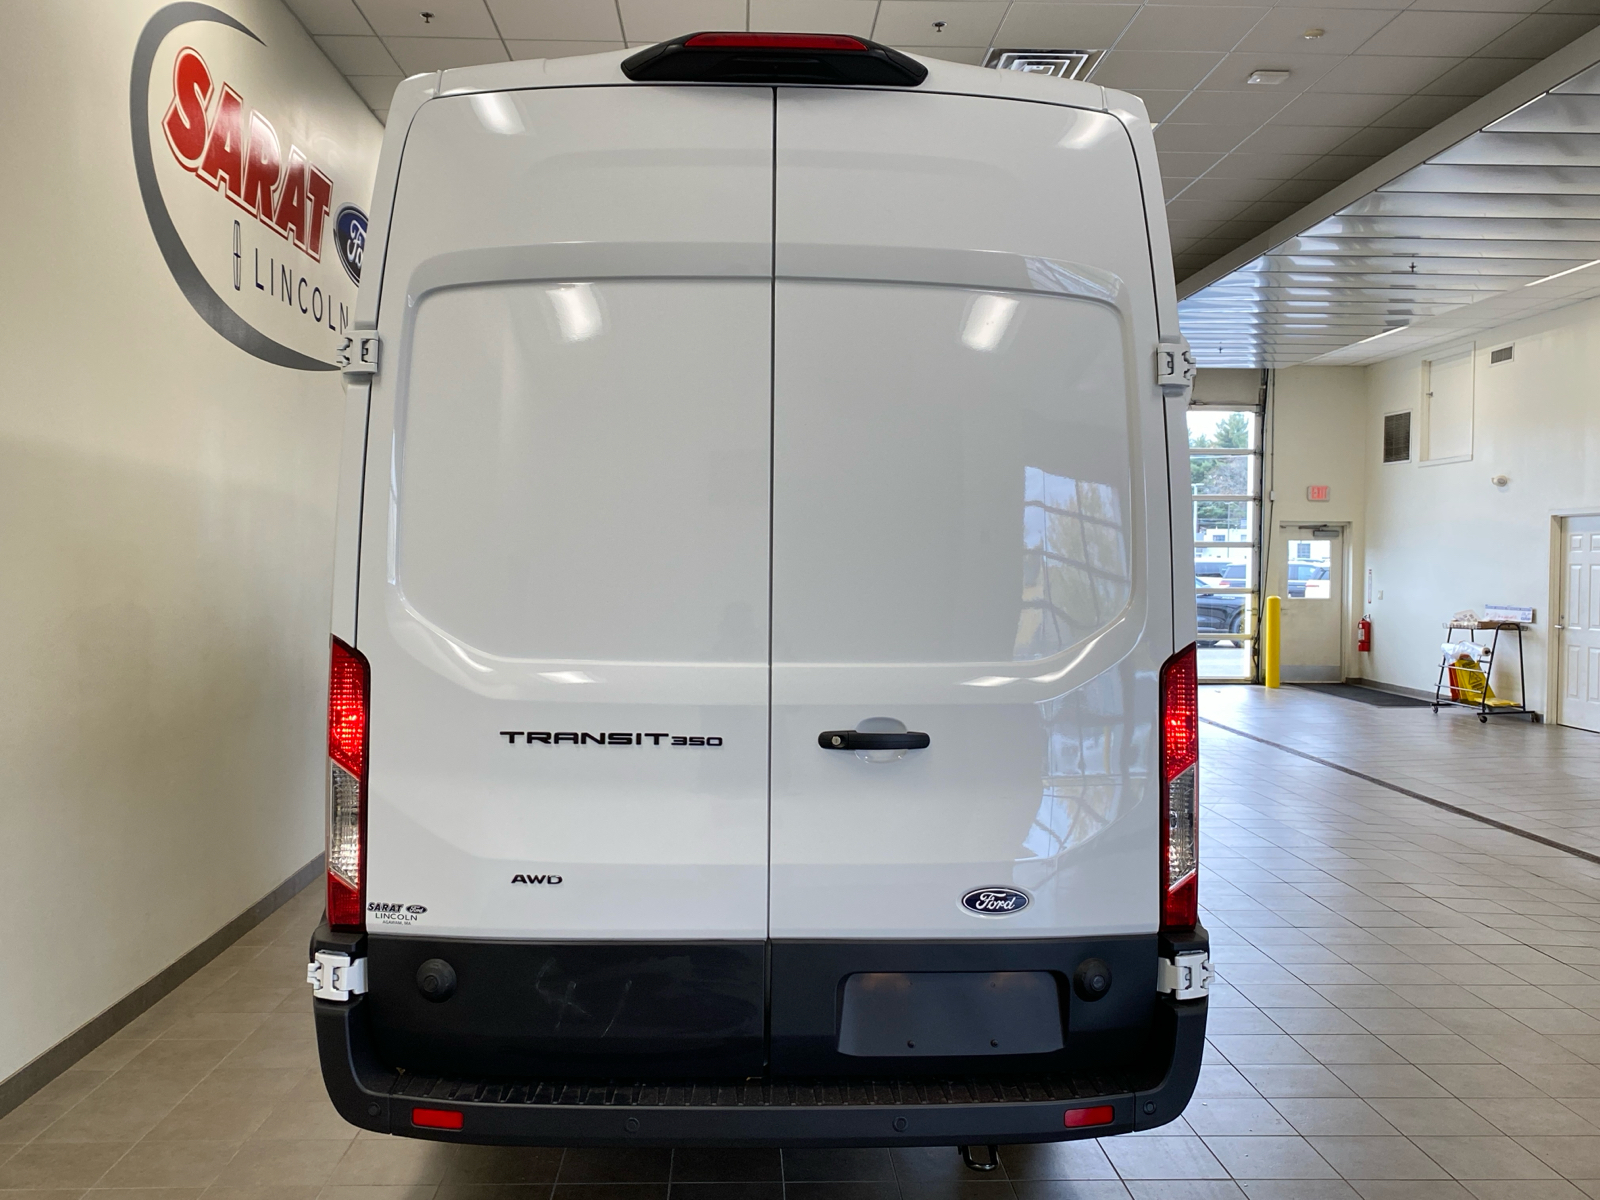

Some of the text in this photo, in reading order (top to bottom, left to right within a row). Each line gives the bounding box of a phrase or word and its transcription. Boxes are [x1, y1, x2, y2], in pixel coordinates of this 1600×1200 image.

[162, 46, 334, 264] SARAT
[255, 248, 349, 335] LINCOLN
[1311, 486, 1328, 499] EXIT
[510, 874, 563, 885] AWD
[367, 902, 404, 912] SARAT
[975, 892, 1016, 910] Ford
[375, 912, 418, 920] LINCOLN
